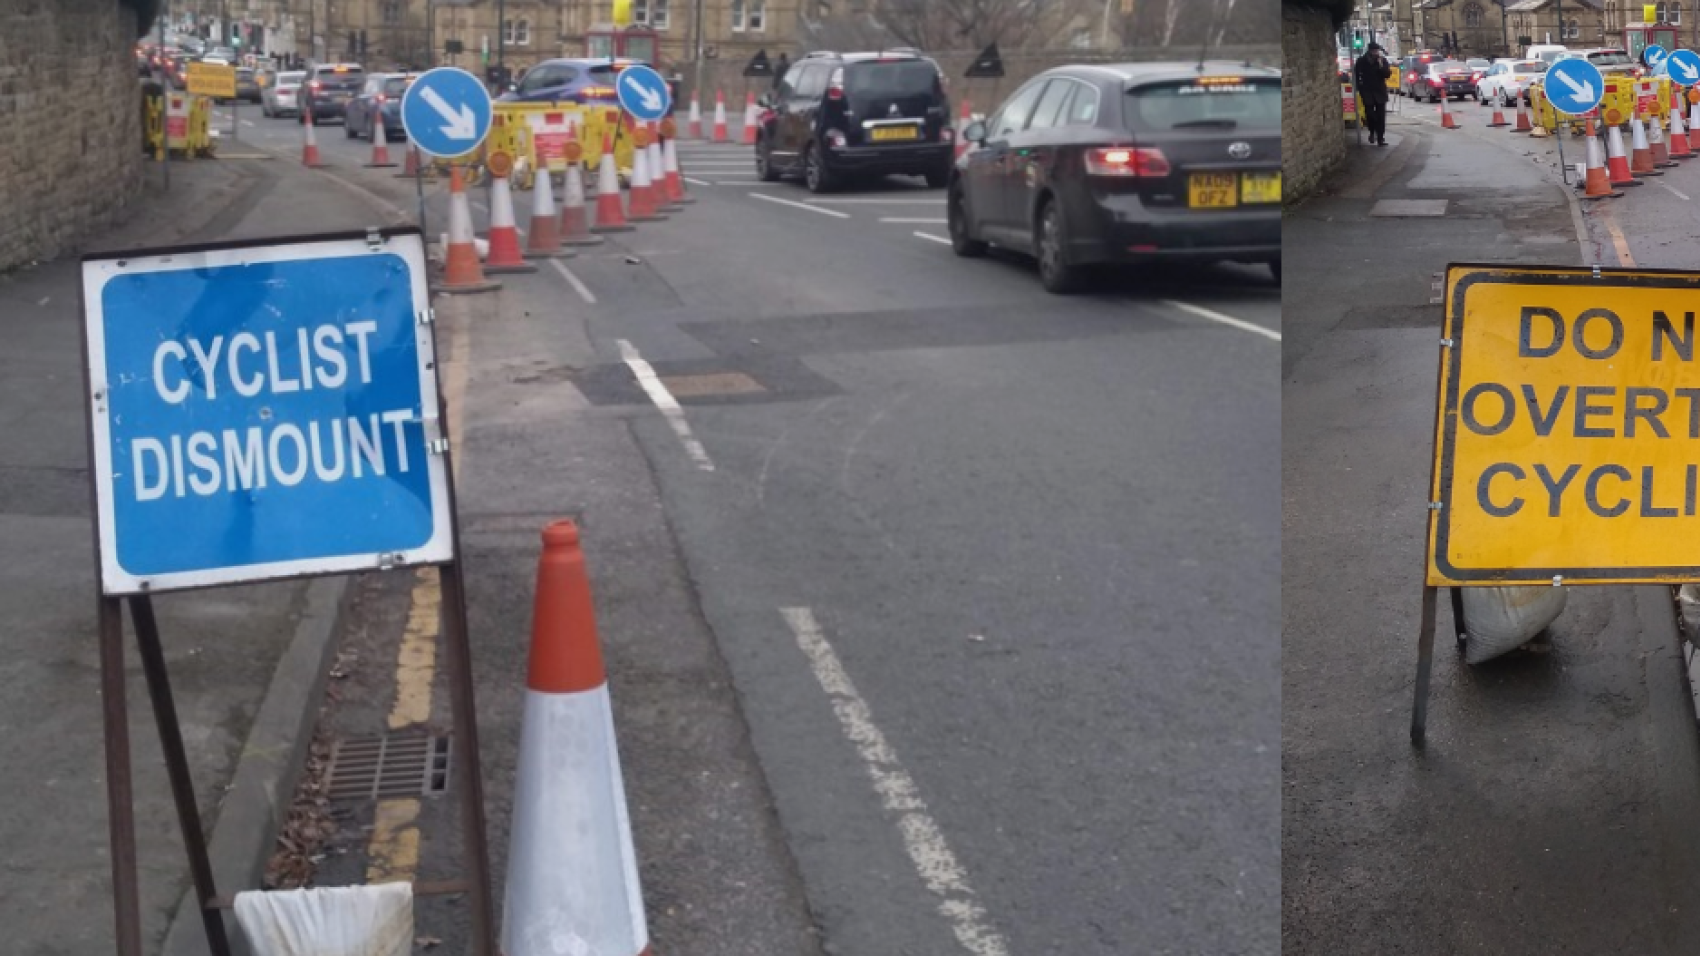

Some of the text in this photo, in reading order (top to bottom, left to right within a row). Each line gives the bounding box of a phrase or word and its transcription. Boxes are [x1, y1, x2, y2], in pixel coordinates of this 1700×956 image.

[152, 320, 378, 405] CYCLIST
[1518, 306, 1696, 362] DO N
[130, 408, 414, 502] DISMOUNT
[1476, 462, 1698, 518] CYCLI
